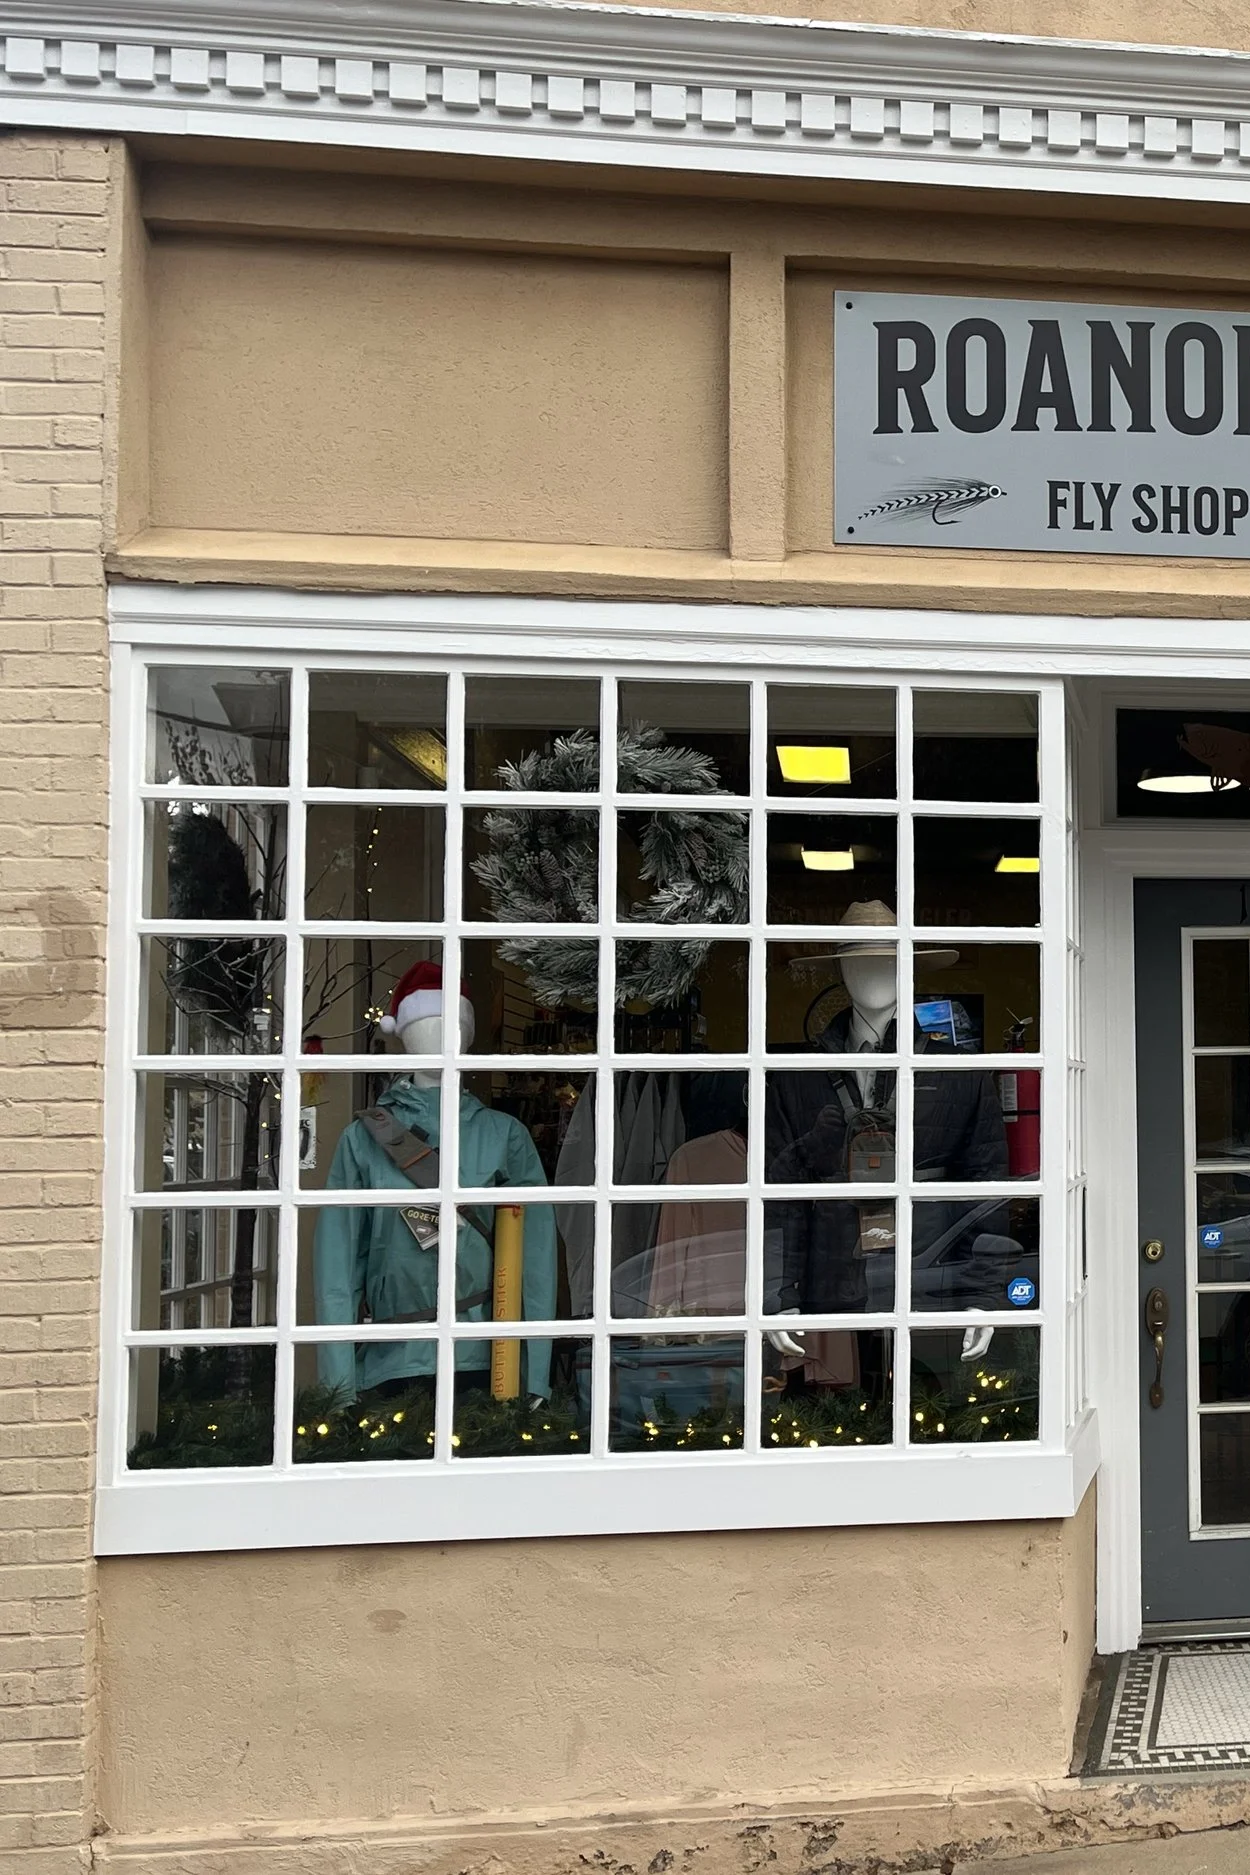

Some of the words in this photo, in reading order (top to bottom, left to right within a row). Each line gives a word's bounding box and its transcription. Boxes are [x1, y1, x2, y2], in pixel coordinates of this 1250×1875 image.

[1046, 479, 1122, 532] FLY
[1131, 483, 1249, 539] SHOP
[407, 1209, 439, 1224] GORE-TE
[1203, 1231, 1221, 1241] ADT
[496, 1267, 507, 1318] STICK
[1011, 1284, 1032, 1296] ADT
[494, 1339, 506, 1395] BUTTE
